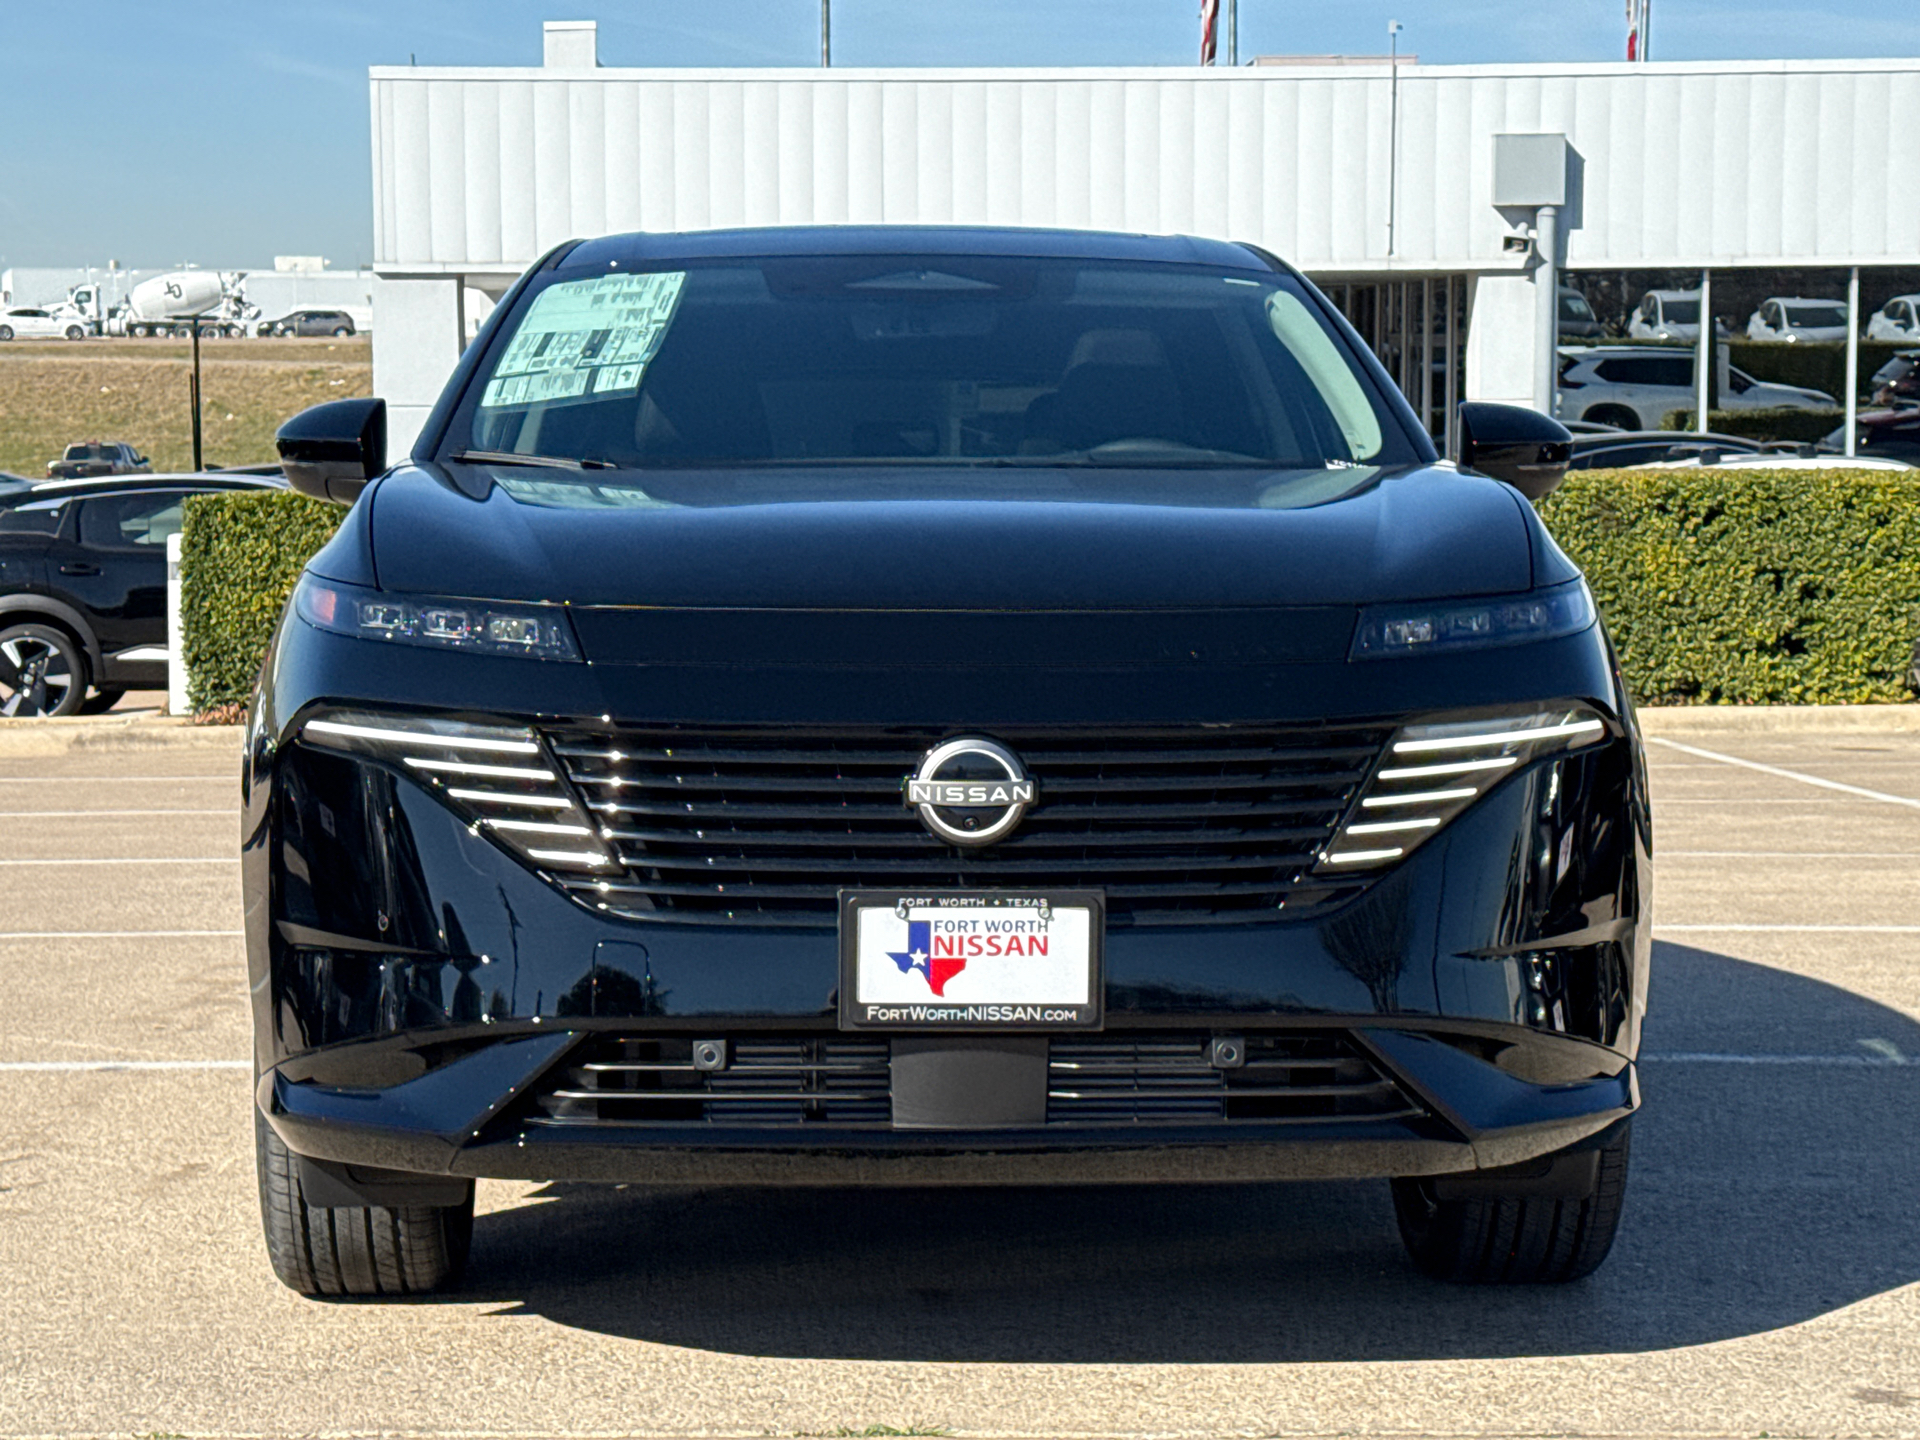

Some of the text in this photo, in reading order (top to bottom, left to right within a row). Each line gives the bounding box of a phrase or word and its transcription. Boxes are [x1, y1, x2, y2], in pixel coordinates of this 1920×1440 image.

[912, 784, 1031, 802] NISSAN
[898, 898, 1049, 908] FORT WORTH TEXAS
[934, 920, 1049, 933] FORT WORTH
[934, 935, 1049, 957] NISSAN
